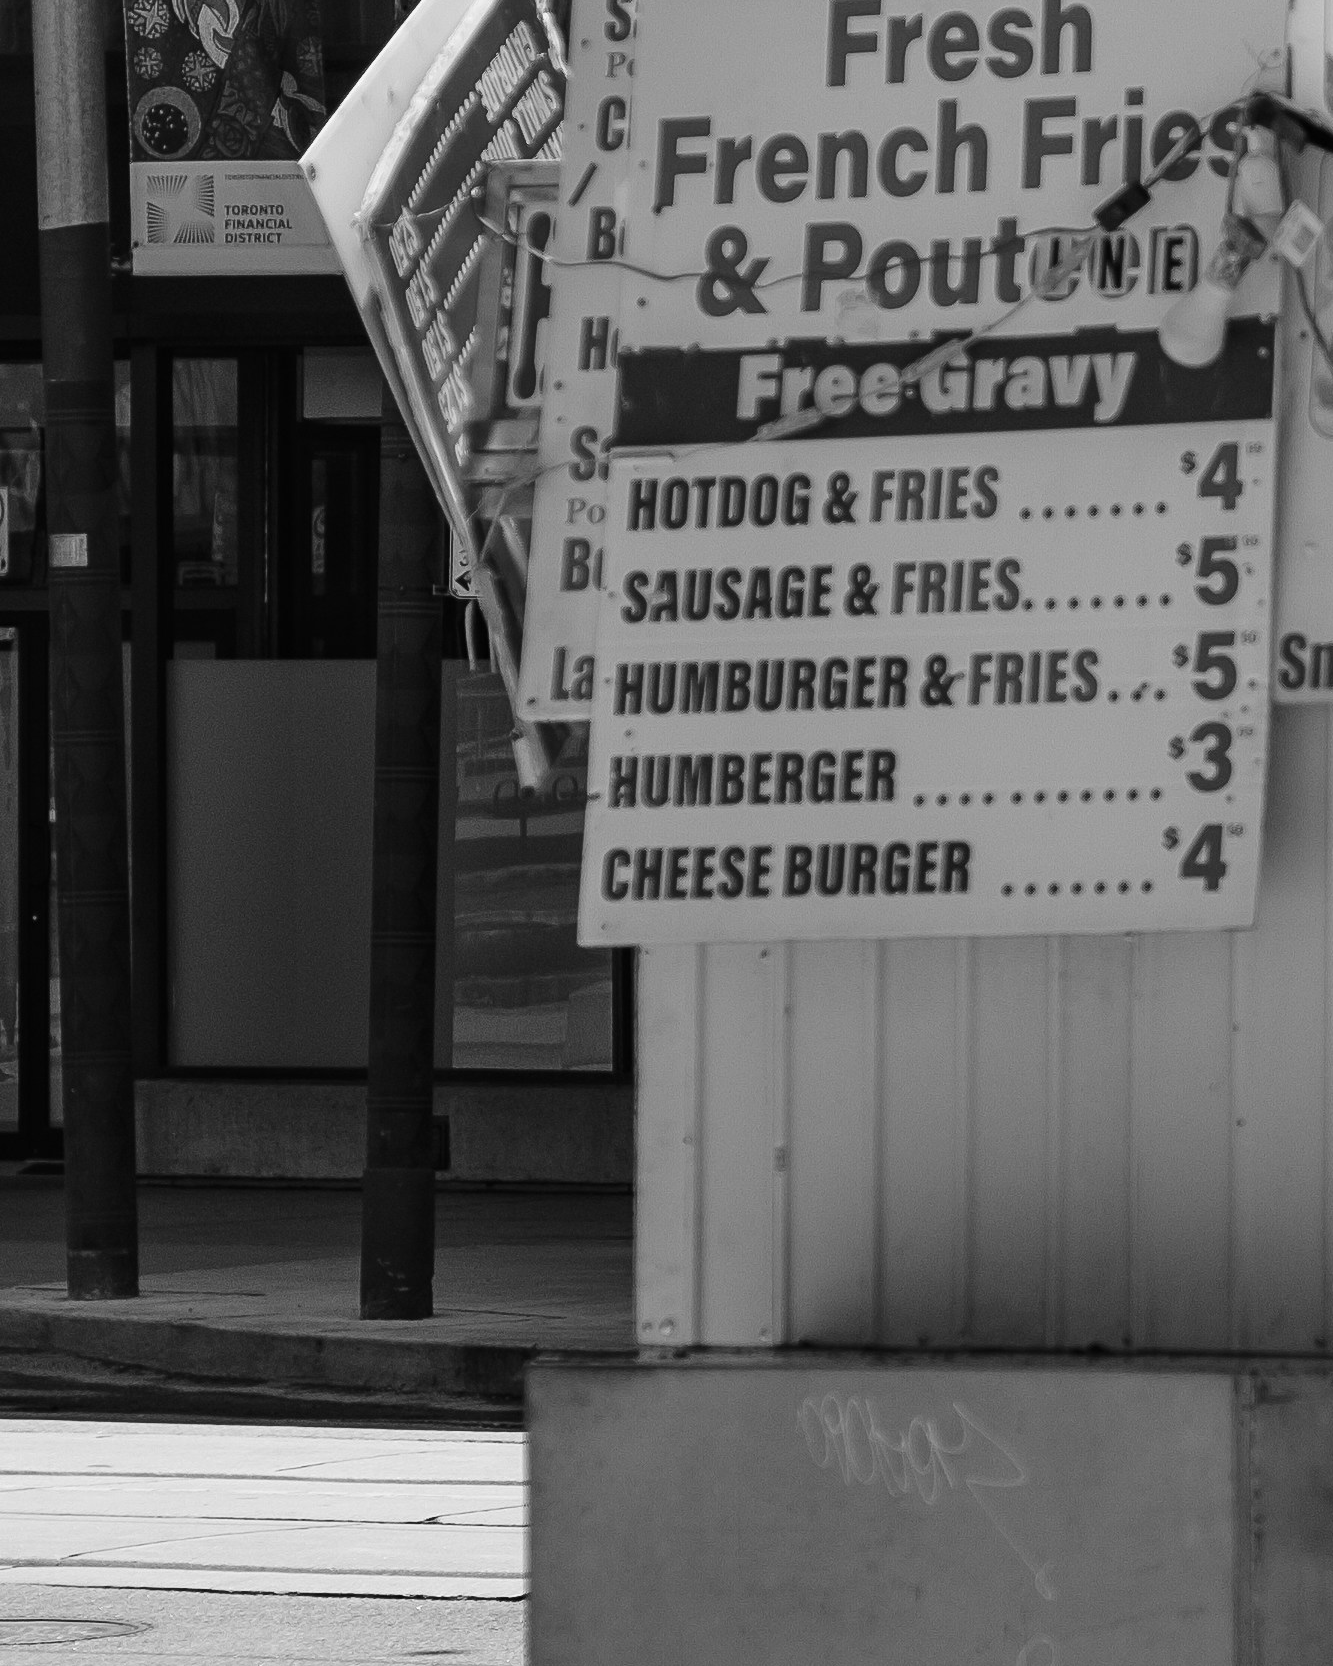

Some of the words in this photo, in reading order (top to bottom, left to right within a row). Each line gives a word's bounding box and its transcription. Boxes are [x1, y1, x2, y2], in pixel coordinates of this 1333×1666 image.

[475, 20, 538, 124] GATORADE
[512, 70, 559, 146] SMALL
[654, 98, 990, 215] French
[1020, 86, 1238, 190] Fries
[224, 204, 284, 216] TORONTO
[224, 218, 293, 229] FINANCIAL
[224, 232, 282, 244] DISTRICT
[695, 225, 771, 318] &
[735, 354, 902, 422] Free
[919, 347, 1138, 424] Gravy
[626, 473, 811, 532] HOTDOG
[823, 471, 858, 526] &
[868, 465, 1001, 524] FRIES
[620, 562, 833, 625] SAUSAGE
[843, 562, 879, 618] &
[889, 556, 1024, 614] FRIES
[613, 653, 910, 717] HUMBURGER
[919, 654, 958, 709] &
[966, 648, 1102, 707] FRIES
[606, 748, 898, 810] HUMBERGER
[601, 842, 773, 903] CHEESE
[782, 839, 973, 898] BURGER
